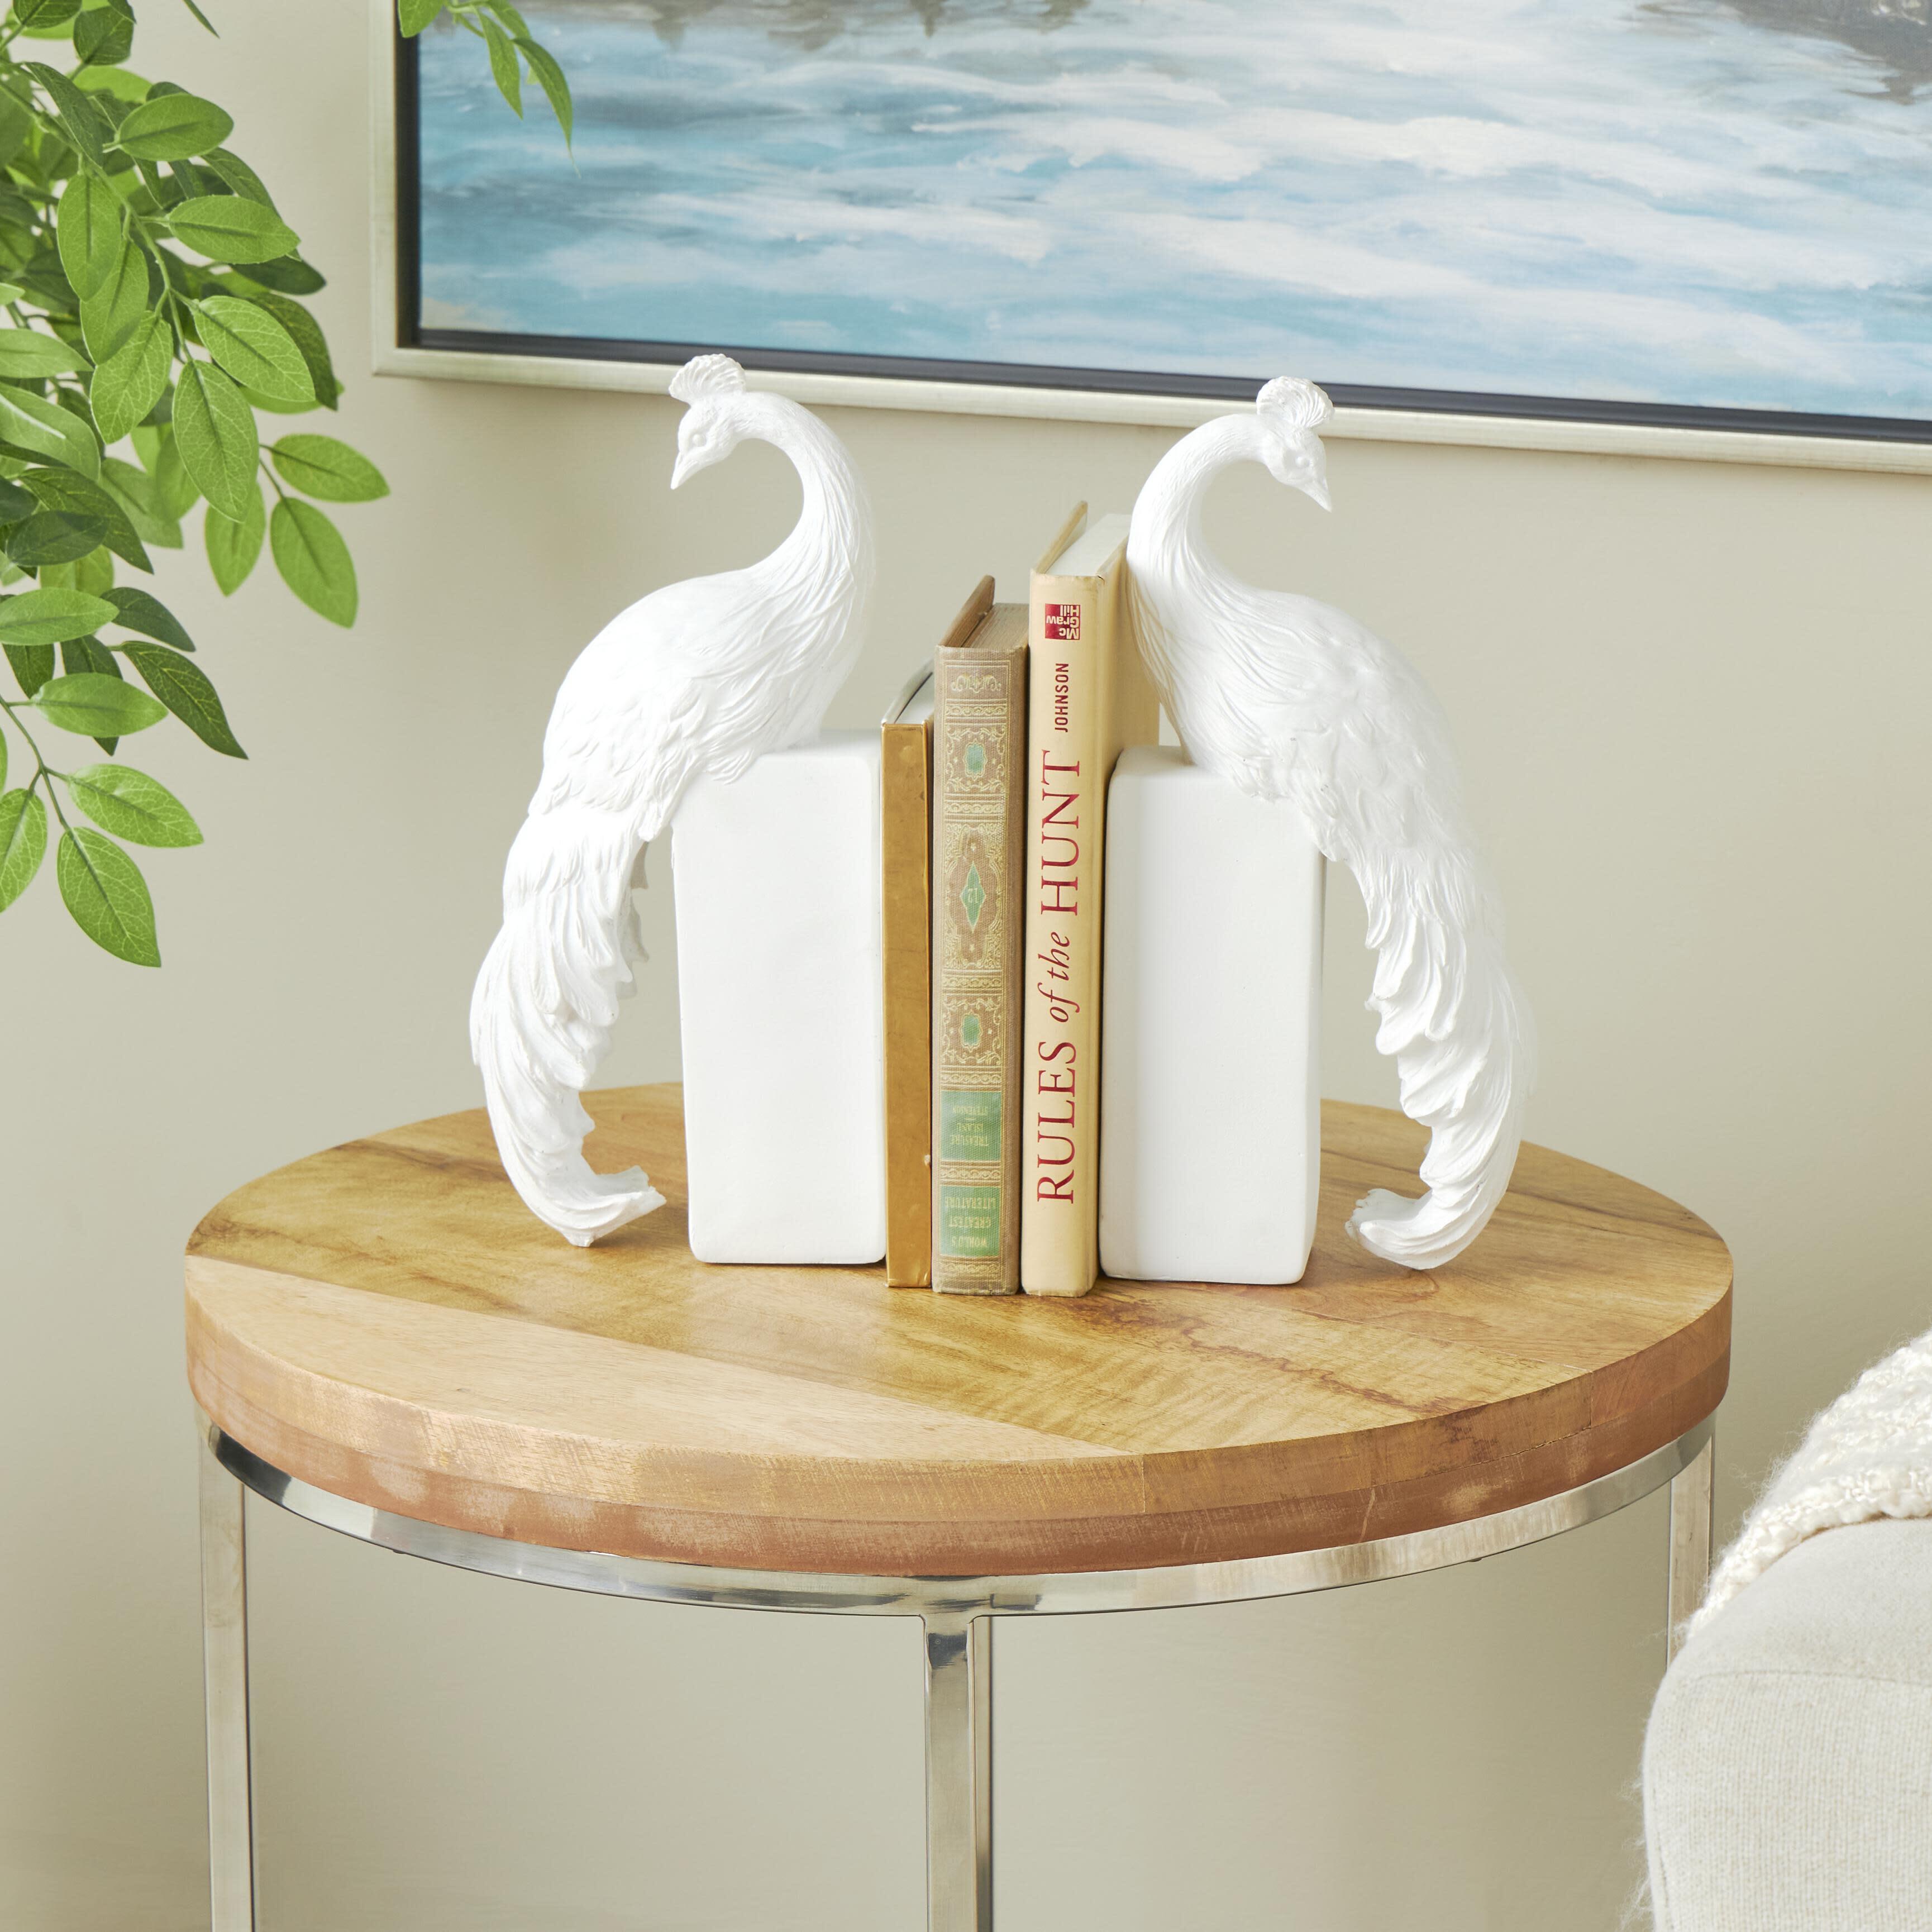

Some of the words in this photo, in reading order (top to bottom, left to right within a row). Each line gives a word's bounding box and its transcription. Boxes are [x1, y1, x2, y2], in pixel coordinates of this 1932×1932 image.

[1060, 605, 1079, 617] Hill
[1046, 616, 1080, 628] Graw
[1059, 628, 1079, 640] Mc
[1054, 663, 1068, 732] JOHNSON
[1041, 750, 1080, 915] HUNT
[1038, 932, 1070, 981] the
[1038, 982, 1080, 1023] of
[1037, 1042, 1076, 1203] RULES
[950, 1134, 990, 1146] TREASURE
[944, 1197, 996, 1209] LITERATURE
[948, 1216, 991, 1228] GREATEST
